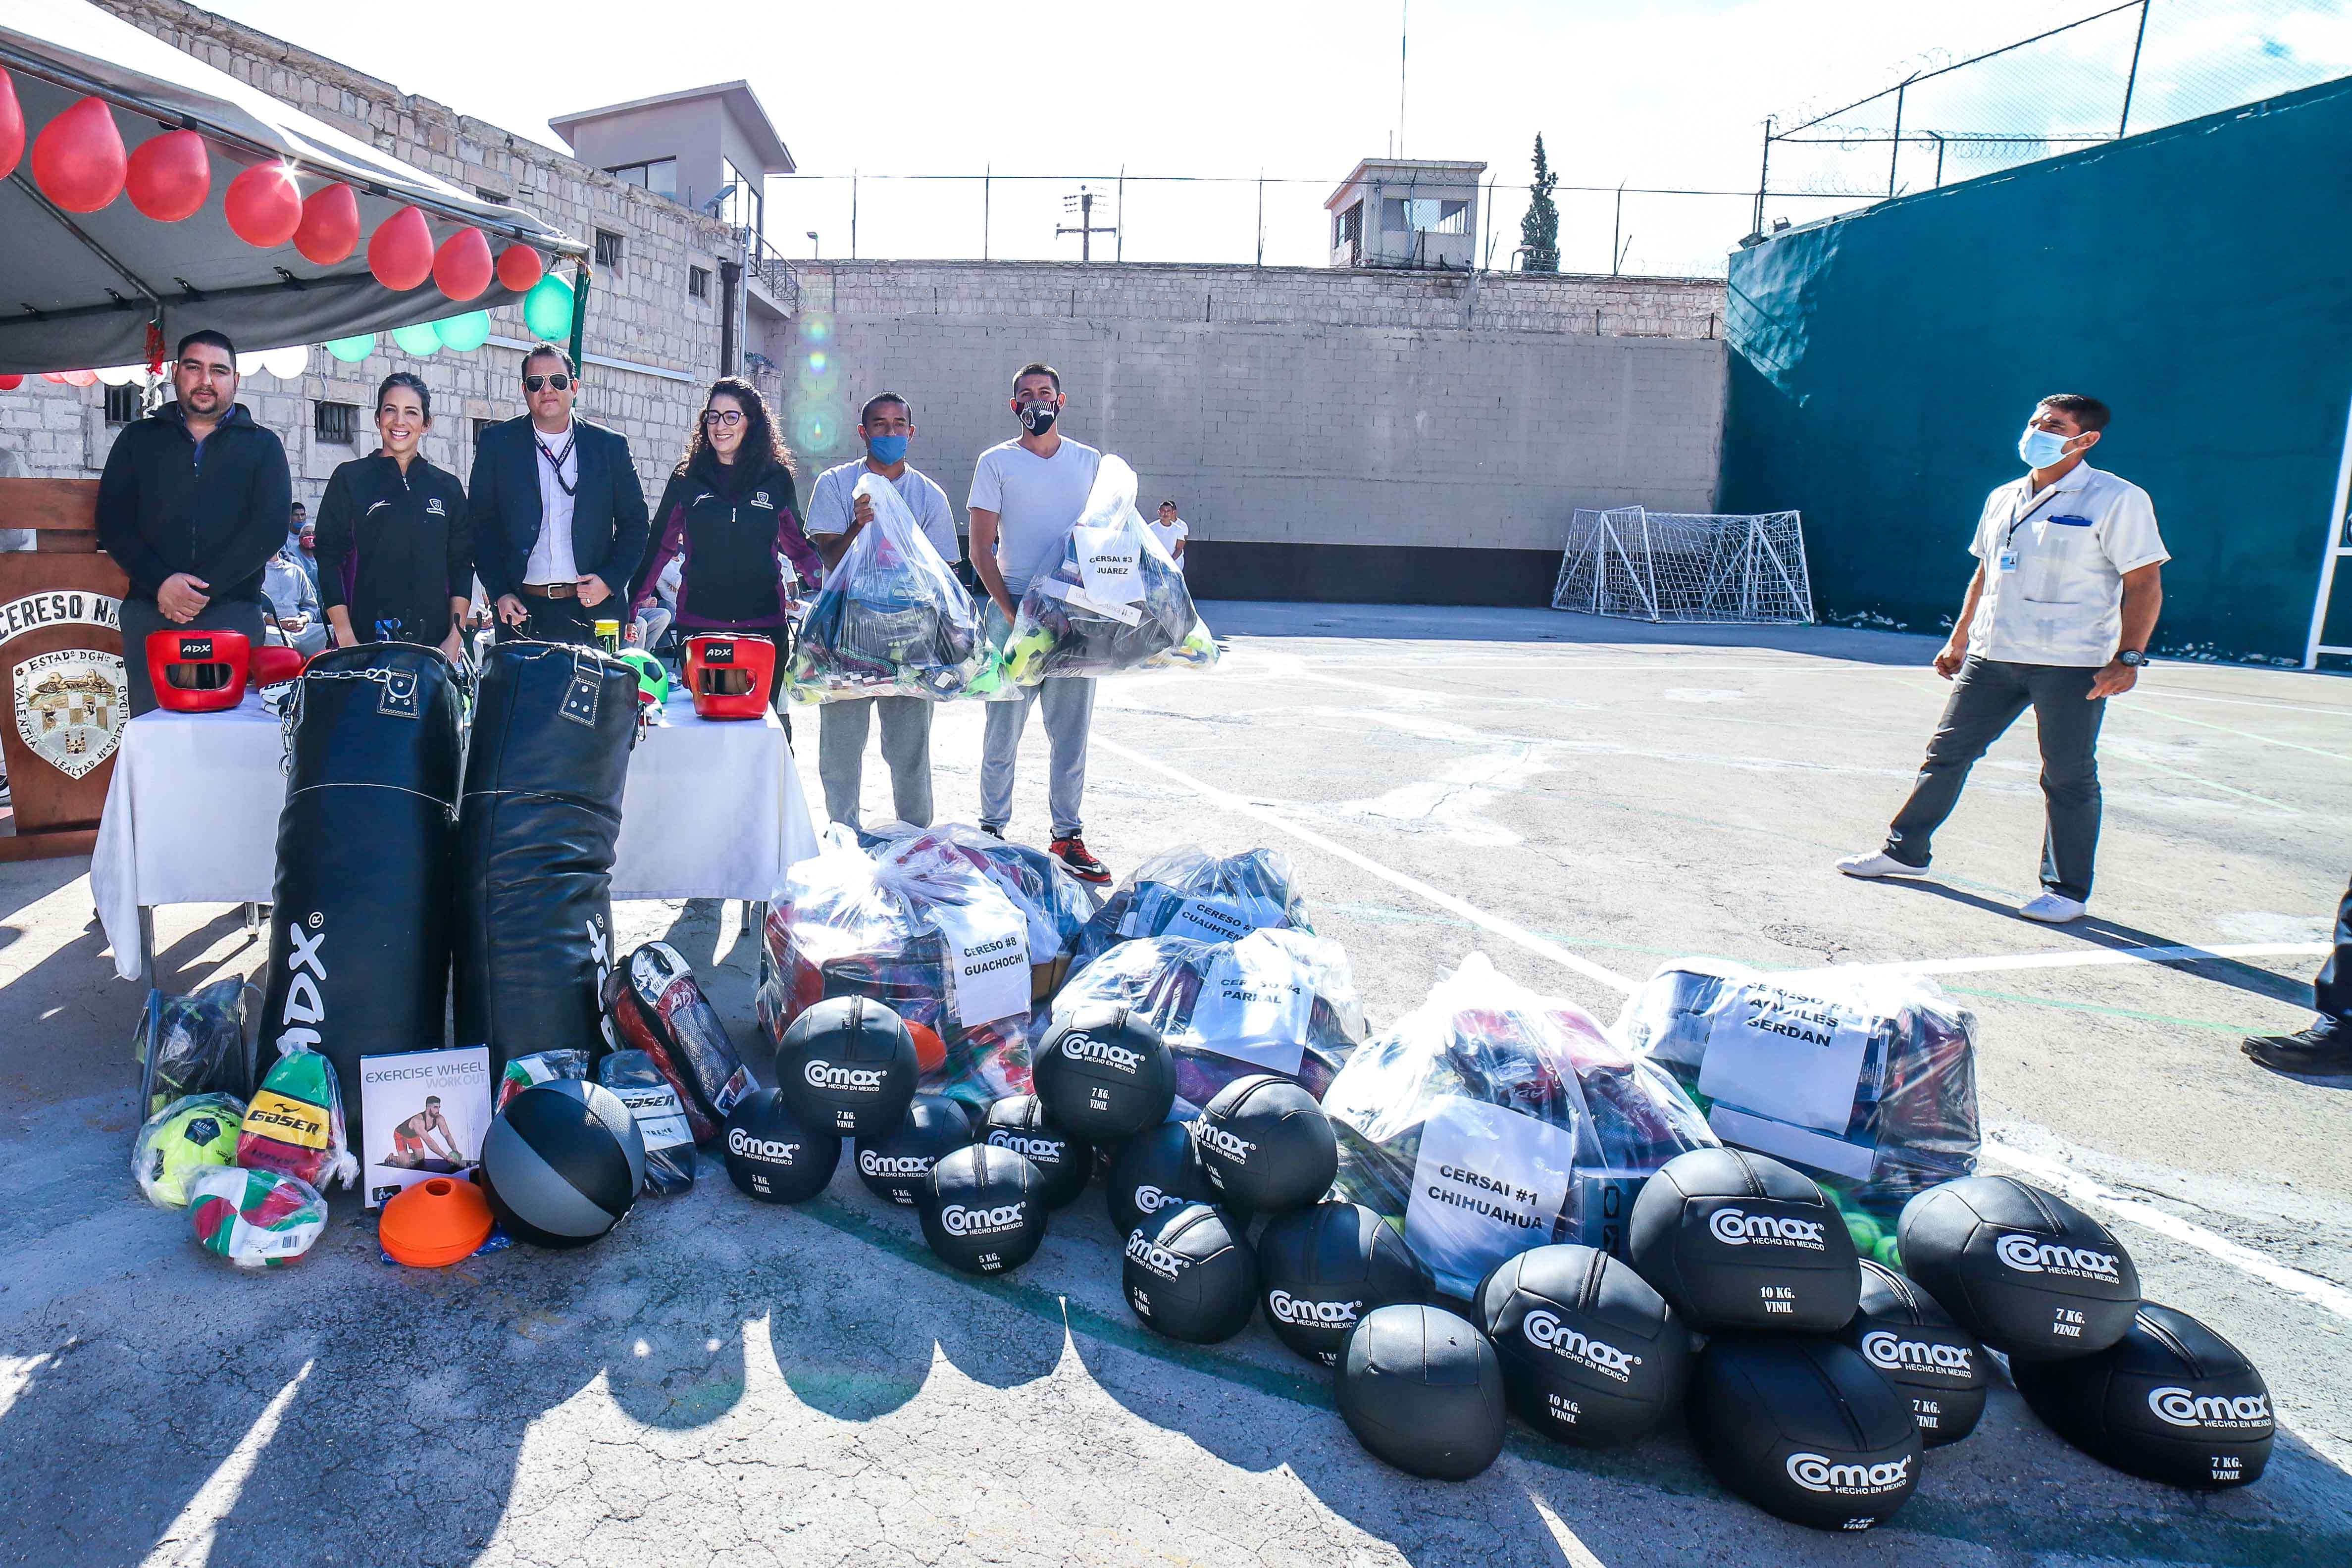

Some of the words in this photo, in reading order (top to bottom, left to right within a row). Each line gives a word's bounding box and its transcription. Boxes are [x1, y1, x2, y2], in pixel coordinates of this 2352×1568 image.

[1097, 565, 1128, 575] JUÁREZ
[0, 595, 83, 640] CERESO
[16, 685, 38, 749] VALENTIA
[53, 757, 95, 776] LEALTAD
[1196, 904, 1241, 927] CERESO
[964, 941, 1004, 957] CERESO
[1005, 937, 1017, 948] #8
[965, 953, 1024, 976] GUACHOCHI
[1221, 979, 1279, 988] CERSO
[1747, 1016, 1832, 1048] SERDAN
[365, 1066, 432, 1083] EXERCISE
[437, 1061, 485, 1076] WHEEL
[1084, 1056, 1105, 1064] HECHO
[1114, 1062, 1135, 1074] MEXICO
[425, 1076, 460, 1089] WORK
[463, 1073, 485, 1085] OUT
[1092, 1088, 1098, 1097] 7
[1098, 1089, 1110, 1100] KG.
[1090, 1099, 1108, 1111] VINIL
[837, 1111, 842, 1119] 7
[843, 1111, 856, 1120] KG.
[196, 1121, 211, 1131] NEON
[836, 1120, 855, 1129] VINIL
[744, 1152, 762, 1161] HECHO
[770, 1157, 793, 1165] MEXICO
[1201, 1139, 1216, 1151] HECHO
[1223, 1151, 1245, 1165] MEXICO
[758, 1176, 769, 1186] KG.
[1440, 1164, 1510, 1197] CERSAI
[1516, 1189, 1538, 1206] #1
[754, 1184, 771, 1194] VINIL
[1135, 1185, 1220, 1214] Com
[1428, 1186, 1543, 1229] CHIHUAHUA
[970, 1227, 991, 1235] HECHO
[1002, 1221, 1023, 1231] MEXICO
[1797, 1240, 1825, 1251] MEXICO
[986, 1253, 1000, 1262] KG.
[982, 1262, 1002, 1271] VINIL
[1131, 1255, 1145, 1267] HECHO
[1146, 1263, 1154, 1271] EN
[1154, 1267, 1176, 1283] MEXICO
[2047, 1265, 2080, 1277] HECHO
[2081, 1269, 2094, 1278] EN
[2094, 1272, 2120, 1284] MEXICO
[1138, 1290, 1150, 1305] KG.
[1760, 1287, 1773, 1298] 10
[1776, 1287, 1795, 1299] KG.
[1134, 1299, 1151, 1316] VINIL
[1765, 1301, 1793, 1313] VINIL
[1297, 1318, 1319, 1328] HECHO
[2056, 1308, 2064, 1320] 7
[2066, 1310, 2086, 1324] KG.
[2053, 1322, 2081, 1337] VINIL
[1555, 1347, 1584, 1363] HECHO
[1585, 1360, 1596, 1369] EN
[1597, 1363, 1629, 1383] MEXICO
[1905, 1363, 1934, 1373] HECHO
[1936, 1366, 1947, 1375] EN
[1948, 1367, 1972, 1378] MEXICO
[1549, 1394, 1560, 1406] 10
[1563, 1399, 1581, 1414] KG.
[1913, 1399, 1920, 1412] 7
[1921, 1400, 1941, 1414] KG.
[1550, 1407, 1577, 1424] VINIL
[2204, 1419, 2238, 1428] HECHO
[2251, 1419, 2272, 1428] MEXICO
[2211, 1457, 2219, 1467] 7
[2223, 1457, 2243, 1467] KG.
[2211, 1470, 2241, 1480] VINIL
[1835, 1486, 1868, 1495] HECHO
[1883, 1479, 1907, 1492] MEXICO
